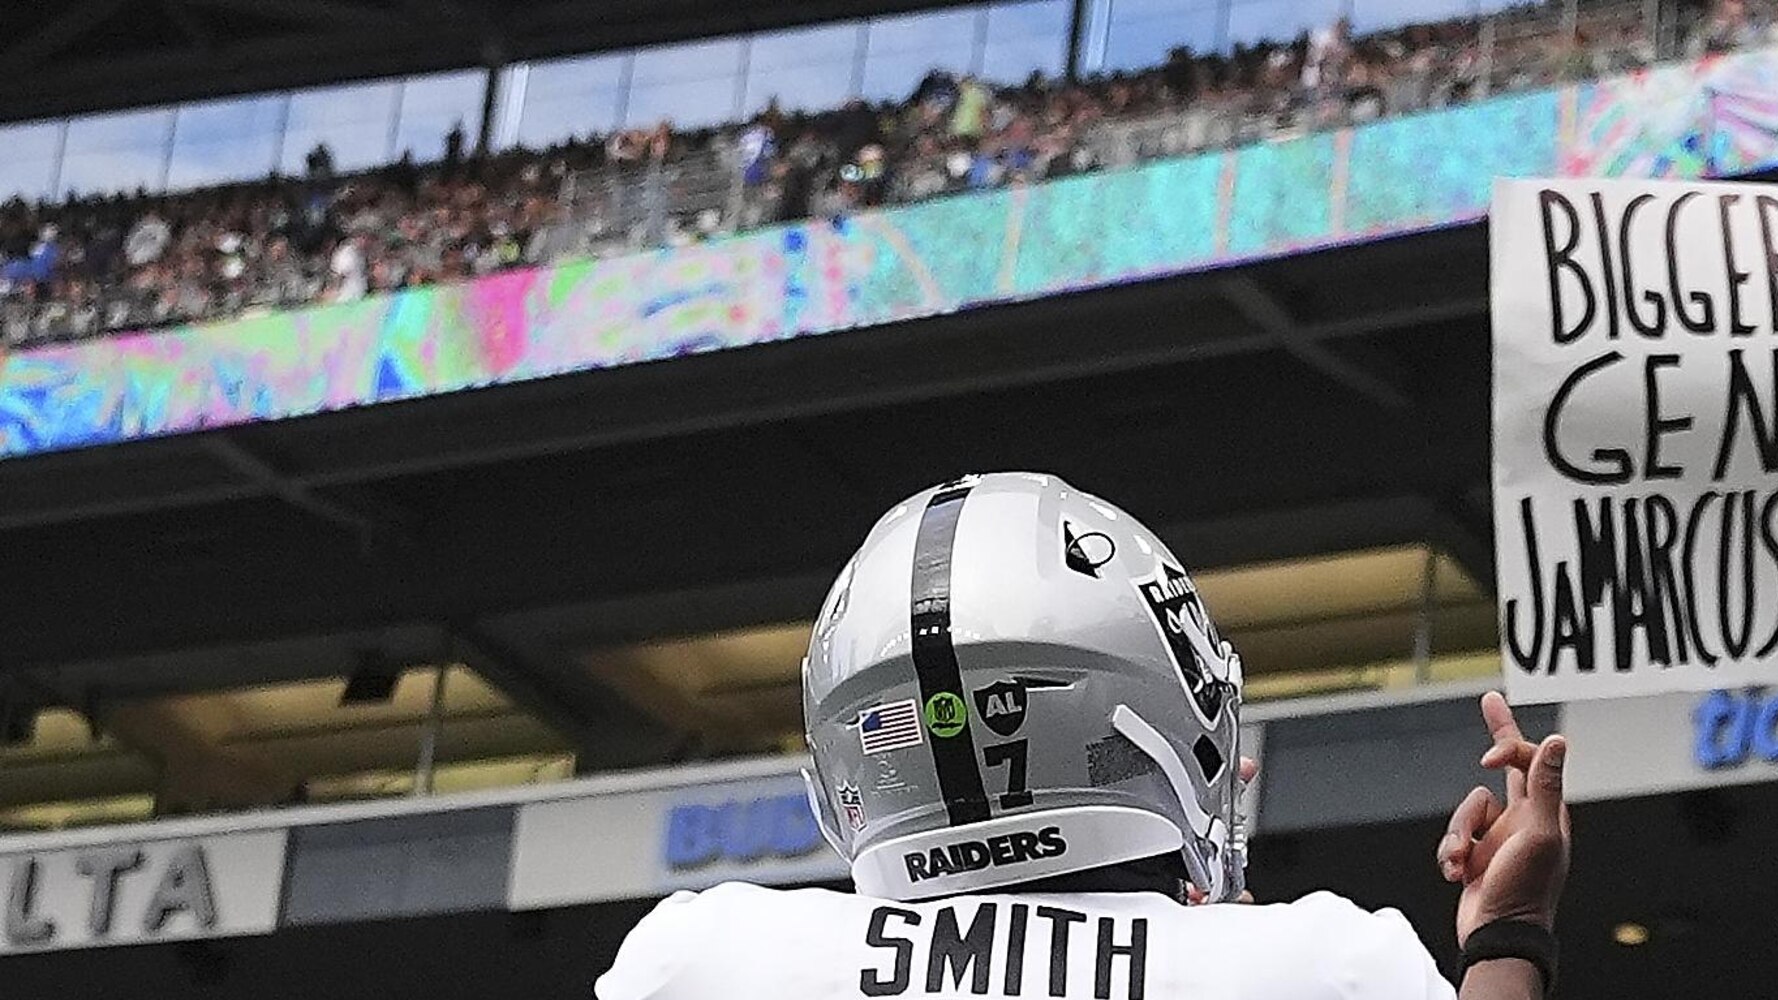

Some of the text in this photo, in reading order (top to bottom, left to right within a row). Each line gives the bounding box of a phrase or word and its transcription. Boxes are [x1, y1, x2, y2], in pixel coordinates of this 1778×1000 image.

[986, 691, 1022, 719] AL
[982, 738, 1035, 811] 7
[903, 826, 1068, 884] RAIDERS
